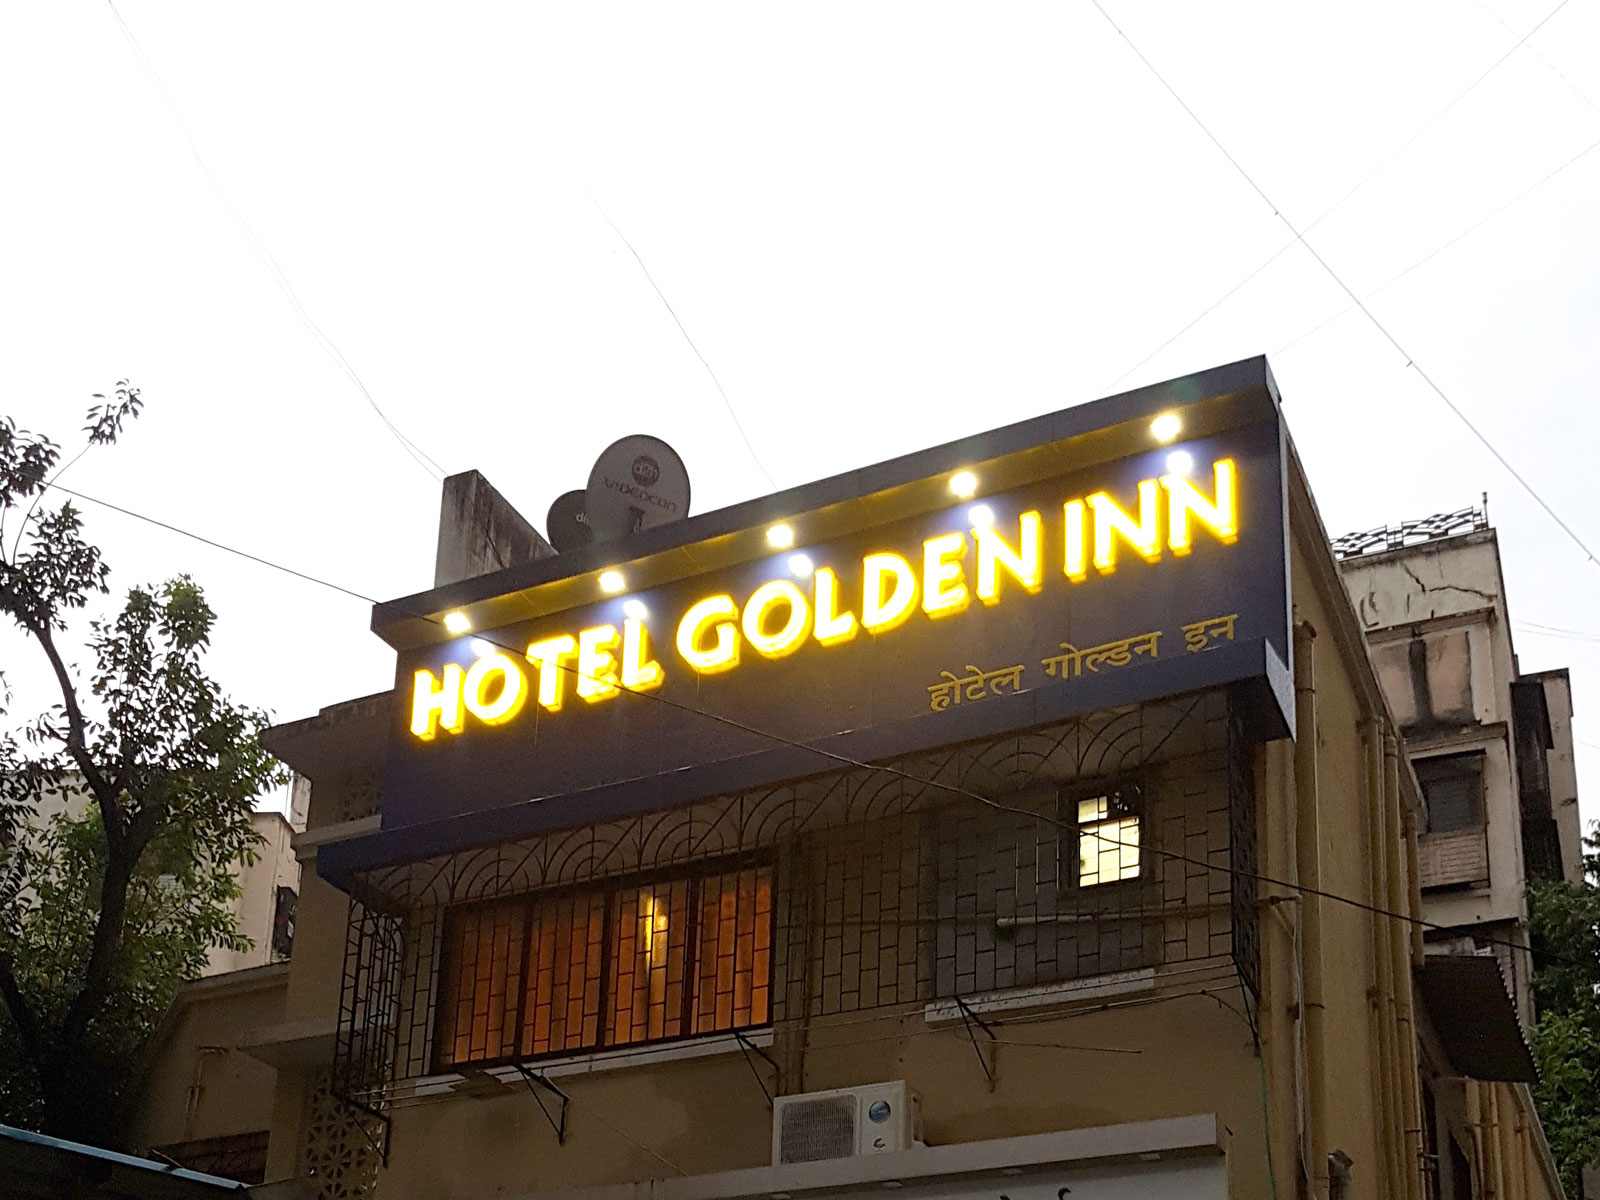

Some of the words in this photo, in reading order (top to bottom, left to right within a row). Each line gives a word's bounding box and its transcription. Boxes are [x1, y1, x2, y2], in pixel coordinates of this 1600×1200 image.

[410, 617, 665, 741] HOTEL
[676, 510, 1043, 674] GOLDEN
[1062, 457, 1238, 583] INN
[927, 664, 1025, 713] होटेल
[1041, 630, 1164, 680] गोल्डन
[1181, 613, 1239, 653] इन
